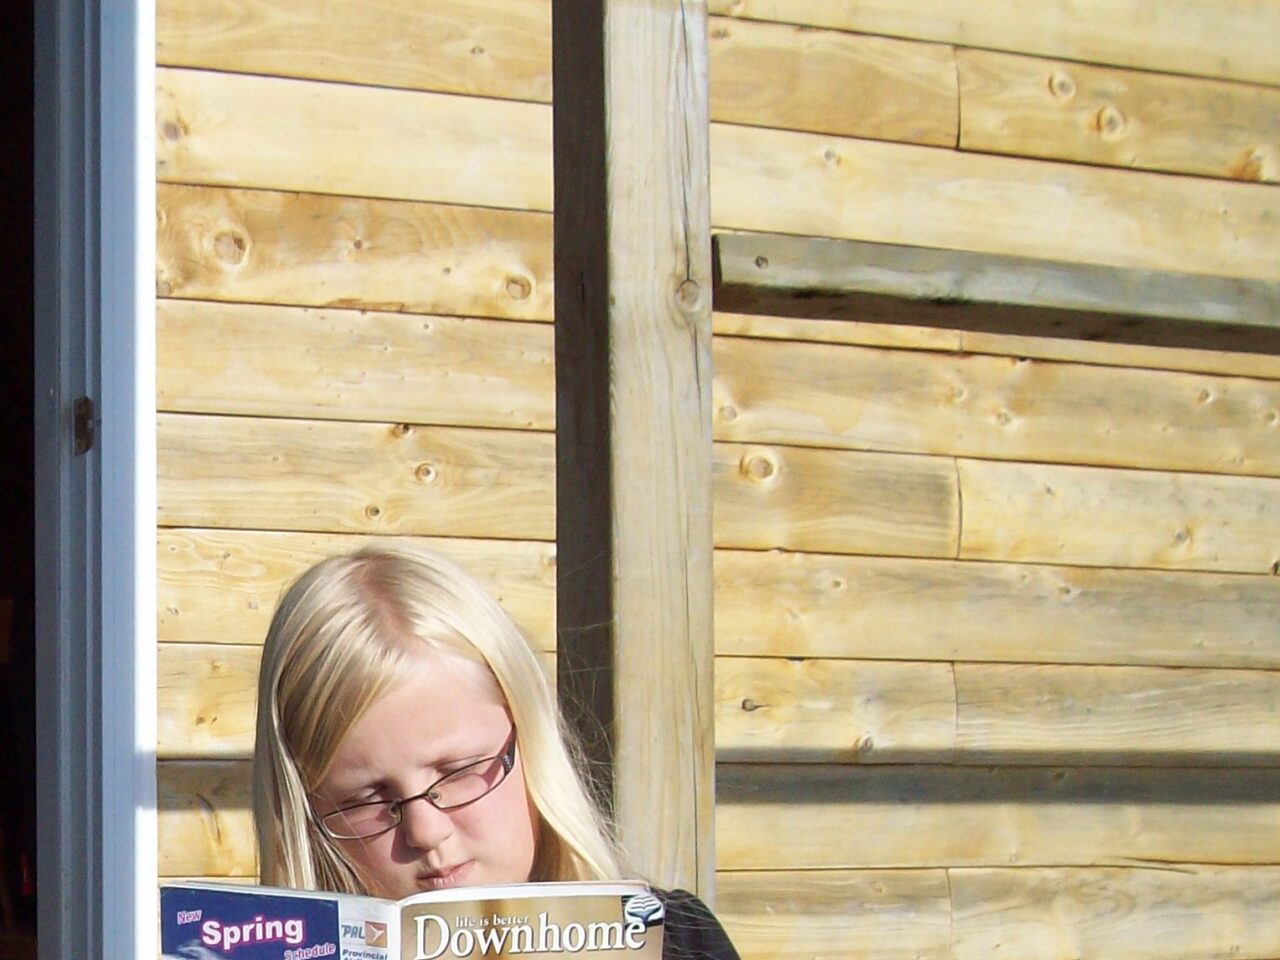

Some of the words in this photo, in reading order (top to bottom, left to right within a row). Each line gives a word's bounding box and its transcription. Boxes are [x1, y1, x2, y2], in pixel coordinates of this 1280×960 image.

[177, 909, 202, 924] New
[456, 916, 475, 928] life
[480, 916, 489, 927] is
[493, 914, 529, 926] better
[202, 917, 303, 949] Spring
[341, 925, 365, 939] PAL
[414, 912, 646, 960] Downhome
[343, 949, 387, 960] Provincial
